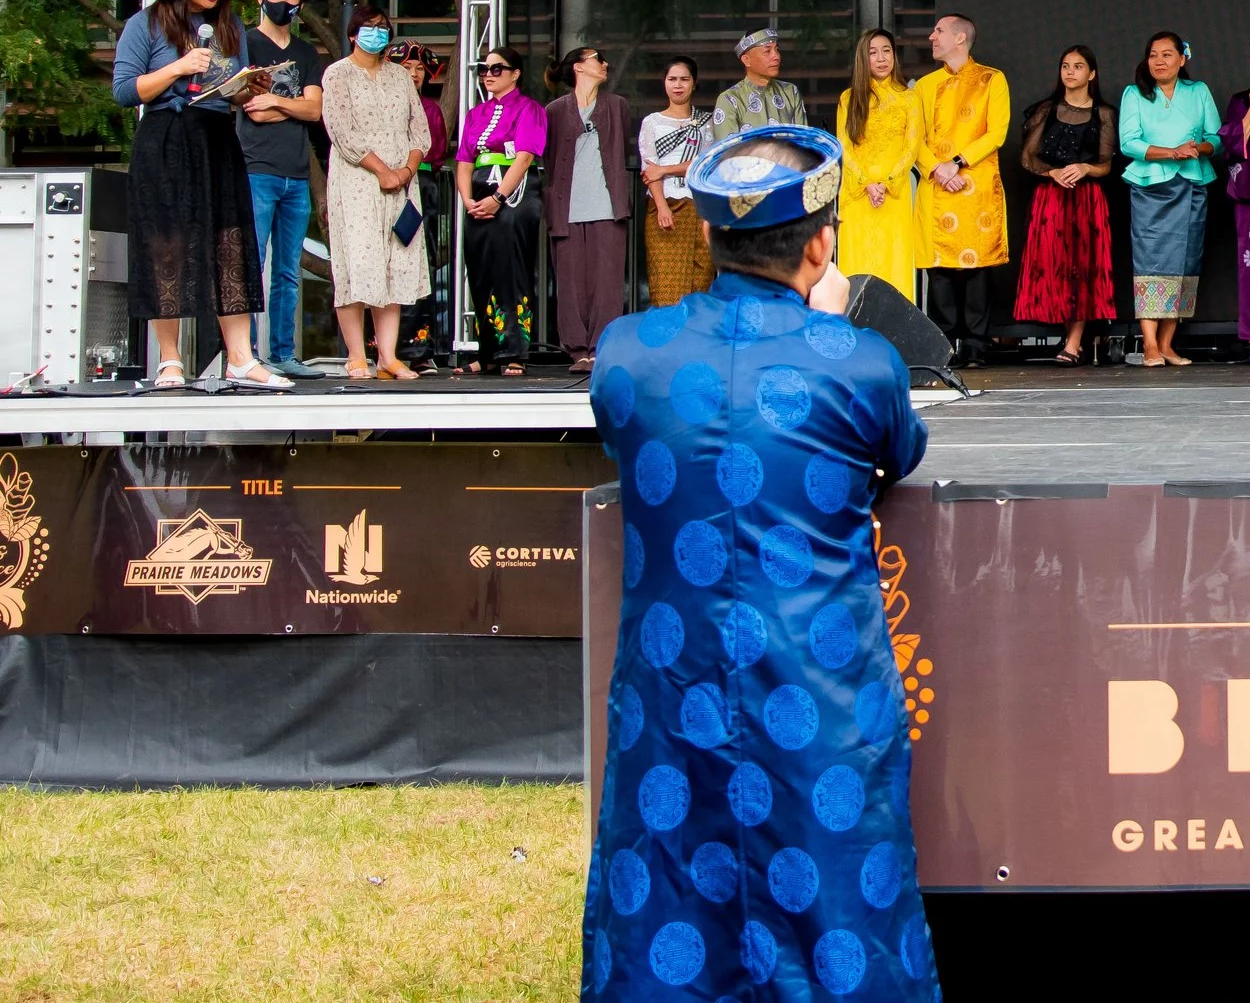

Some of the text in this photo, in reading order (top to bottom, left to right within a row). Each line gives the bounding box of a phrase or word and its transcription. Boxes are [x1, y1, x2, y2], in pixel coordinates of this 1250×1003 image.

[241, 479, 283, 496] TITLE
[495, 560, 537, 568] agriscience
[131, 565, 263, 580] PRAIRIE MEADOWS
